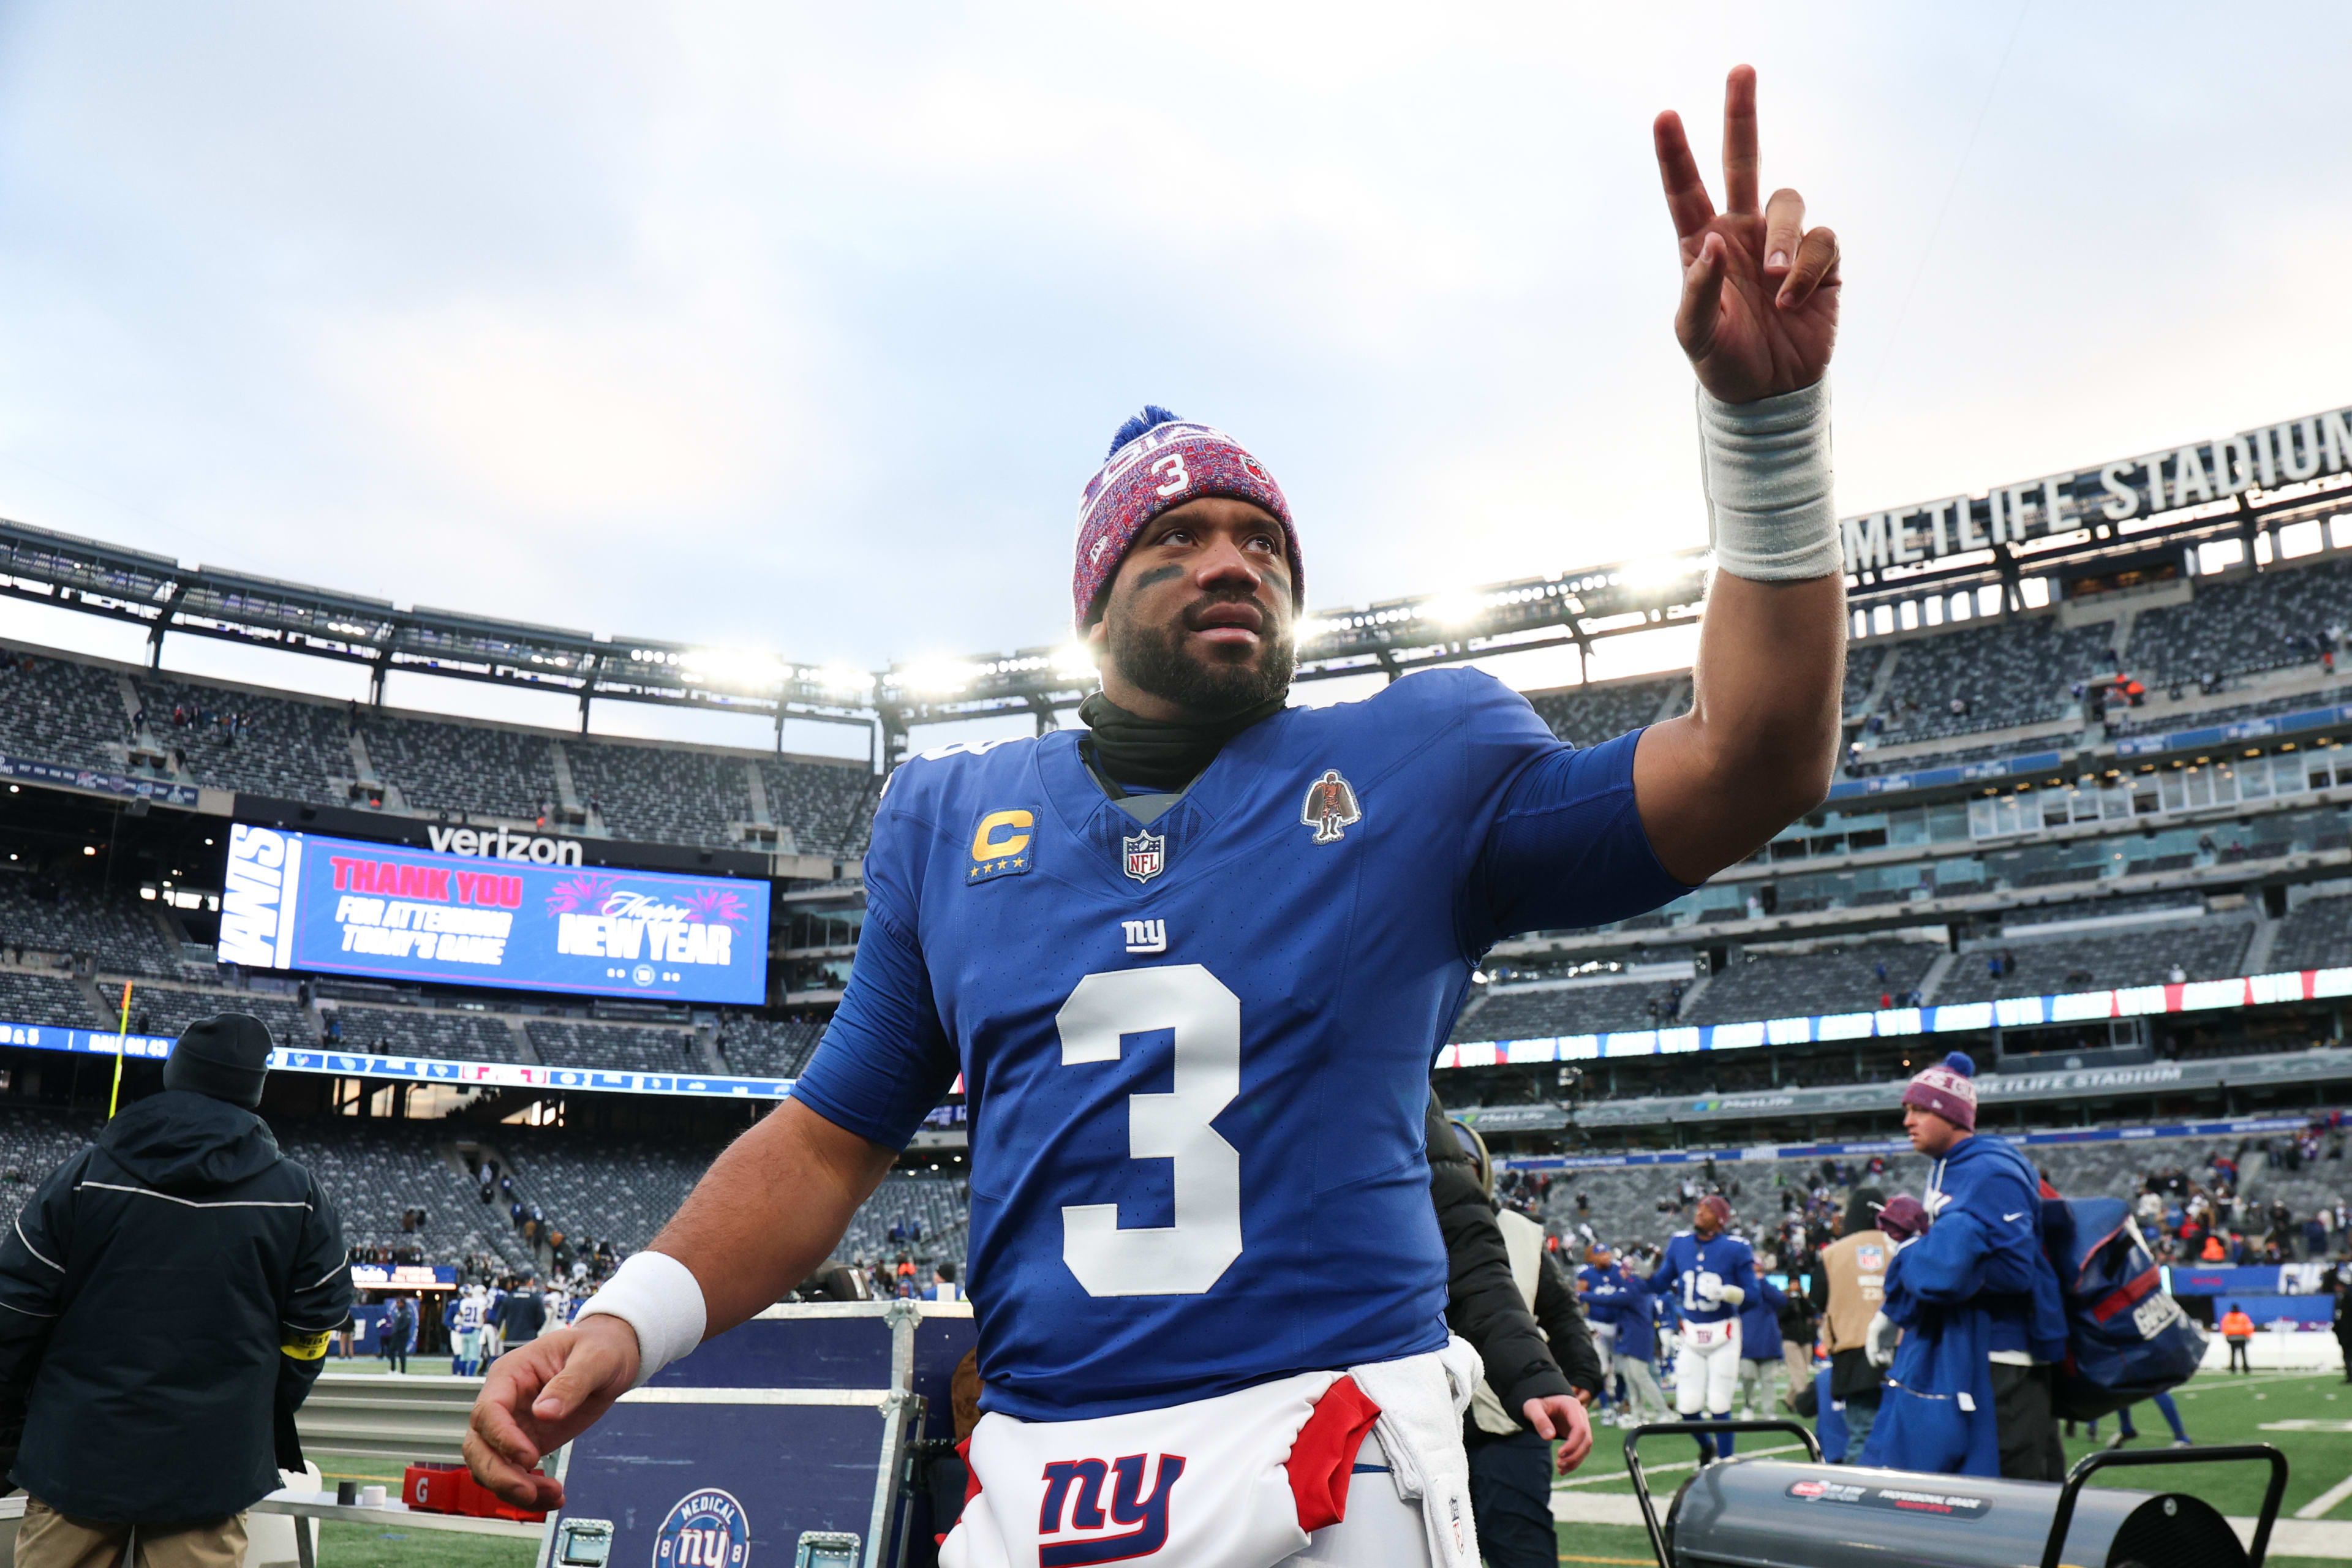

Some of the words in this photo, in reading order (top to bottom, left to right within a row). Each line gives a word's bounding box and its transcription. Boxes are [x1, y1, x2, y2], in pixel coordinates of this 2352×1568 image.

[1150, 453, 1190, 497] 3
[1841, 472, 2082, 575] METLIFE
[2100, 409, 2352, 521] STADIUM
[428, 825, 582, 867] verizon
[973, 810, 1034, 862] C
[1130, 853, 1157, 874] NFL
[330, 856, 451, 902] THANK
[456, 870, 522, 909] YOU
[335, 895, 385, 926] FOR
[601, 891, 690, 924] Happy
[342, 924, 439, 959] TODAY'S
[557, 913, 644, 960] NEW
[647, 919, 731, 966] YEAR
[2073, 1068, 2183, 1088] STADIUM
[1055, 963, 1243, 1297] 3
[464, 1306, 478, 1323] 21
[416, 1477, 428, 1503] G
[681, 1496, 735, 1525] MEDICAL
[660, 1540, 671, 1558] 8
[731, 1544, 742, 1562] 8
